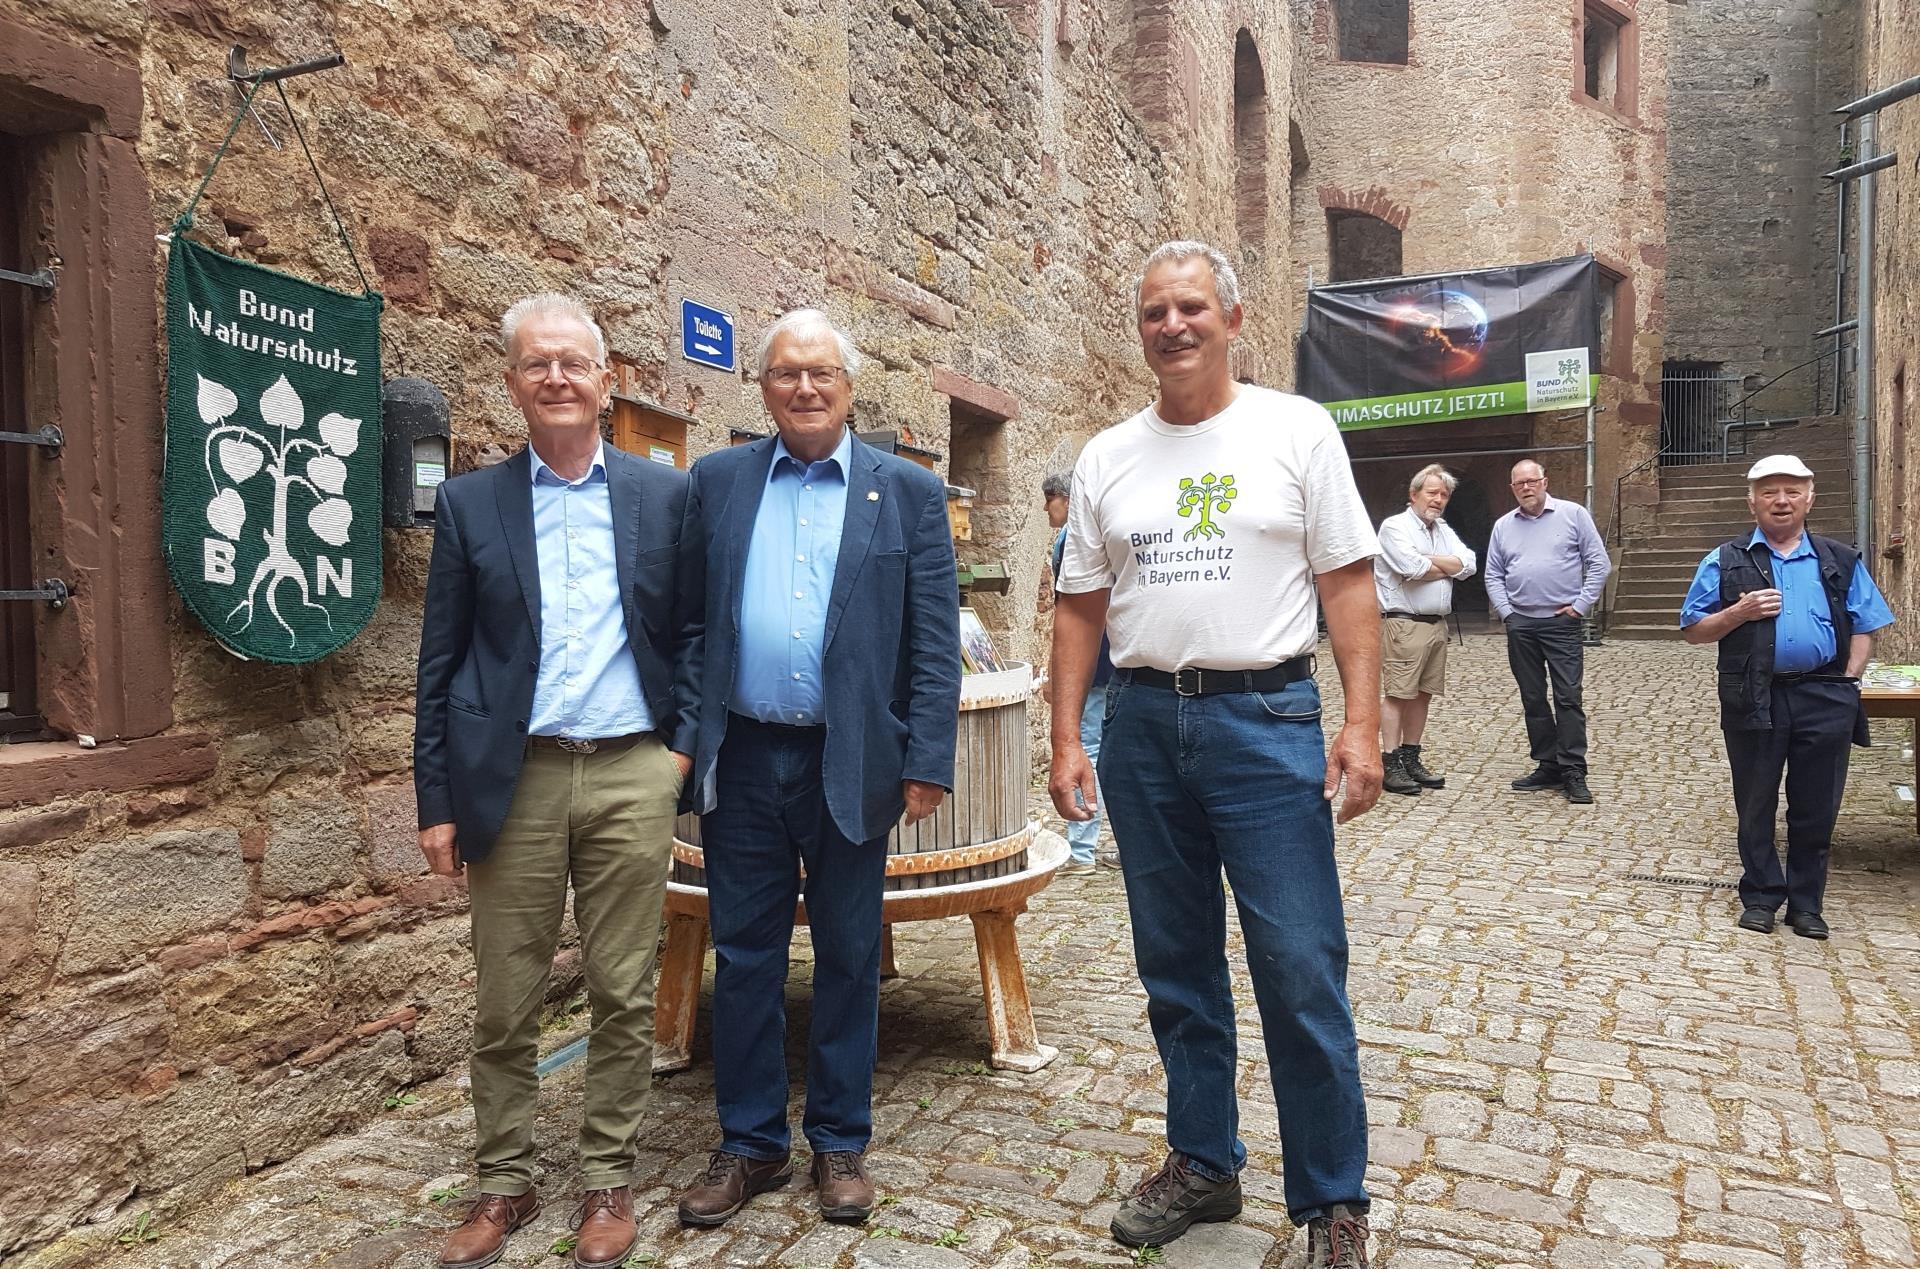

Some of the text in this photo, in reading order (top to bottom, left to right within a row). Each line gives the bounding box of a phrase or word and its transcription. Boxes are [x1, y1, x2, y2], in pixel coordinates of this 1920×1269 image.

[239, 288, 314, 333] Bund
[188, 302, 358, 375] Naturschutz
[693, 316, 723, 341] Toilette
[1537, 379, 1561, 387] BUND
[1537, 386, 1579, 395] Naturschutz
[1328, 392, 1505, 424] IMASCHUTZ JETZT!
[1545, 395, 1567, 403] Bayern
[1131, 528, 1173, 547] Bund
[1135, 546, 1234, 566] Naturschutz
[204, 537, 352, 598] B N
[1138, 566, 1231, 586] in Bayern e.V.
